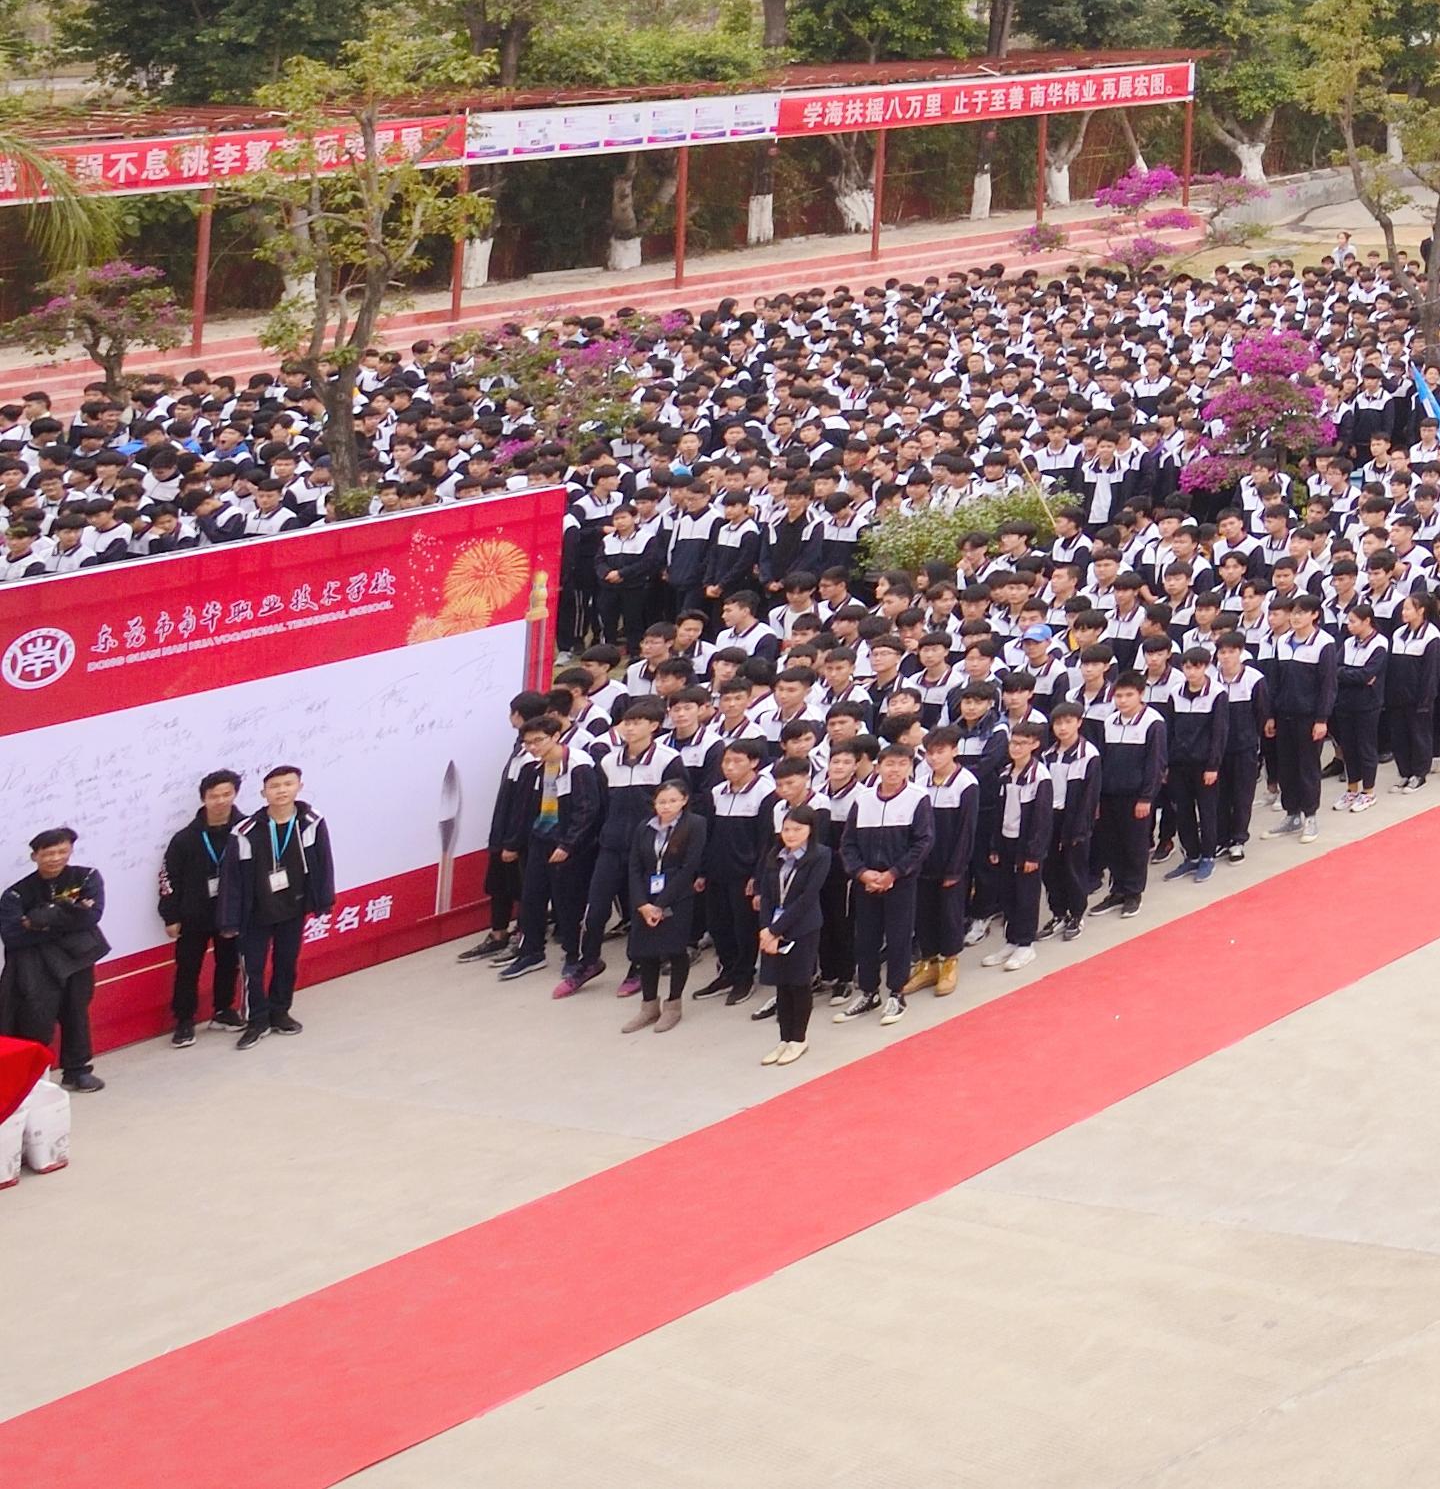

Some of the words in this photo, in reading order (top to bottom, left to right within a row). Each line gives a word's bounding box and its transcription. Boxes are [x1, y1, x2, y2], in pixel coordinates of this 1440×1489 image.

[802, 93, 942, 128] 学海扶摇八万里
[952, 85, 1025, 116] 止于至善
[1029, 79, 1097, 108] 南华伟业
[42, 148, 170, 190] 强不息
[90, 567, 396, 653] 东莞市南华职业技术学校
